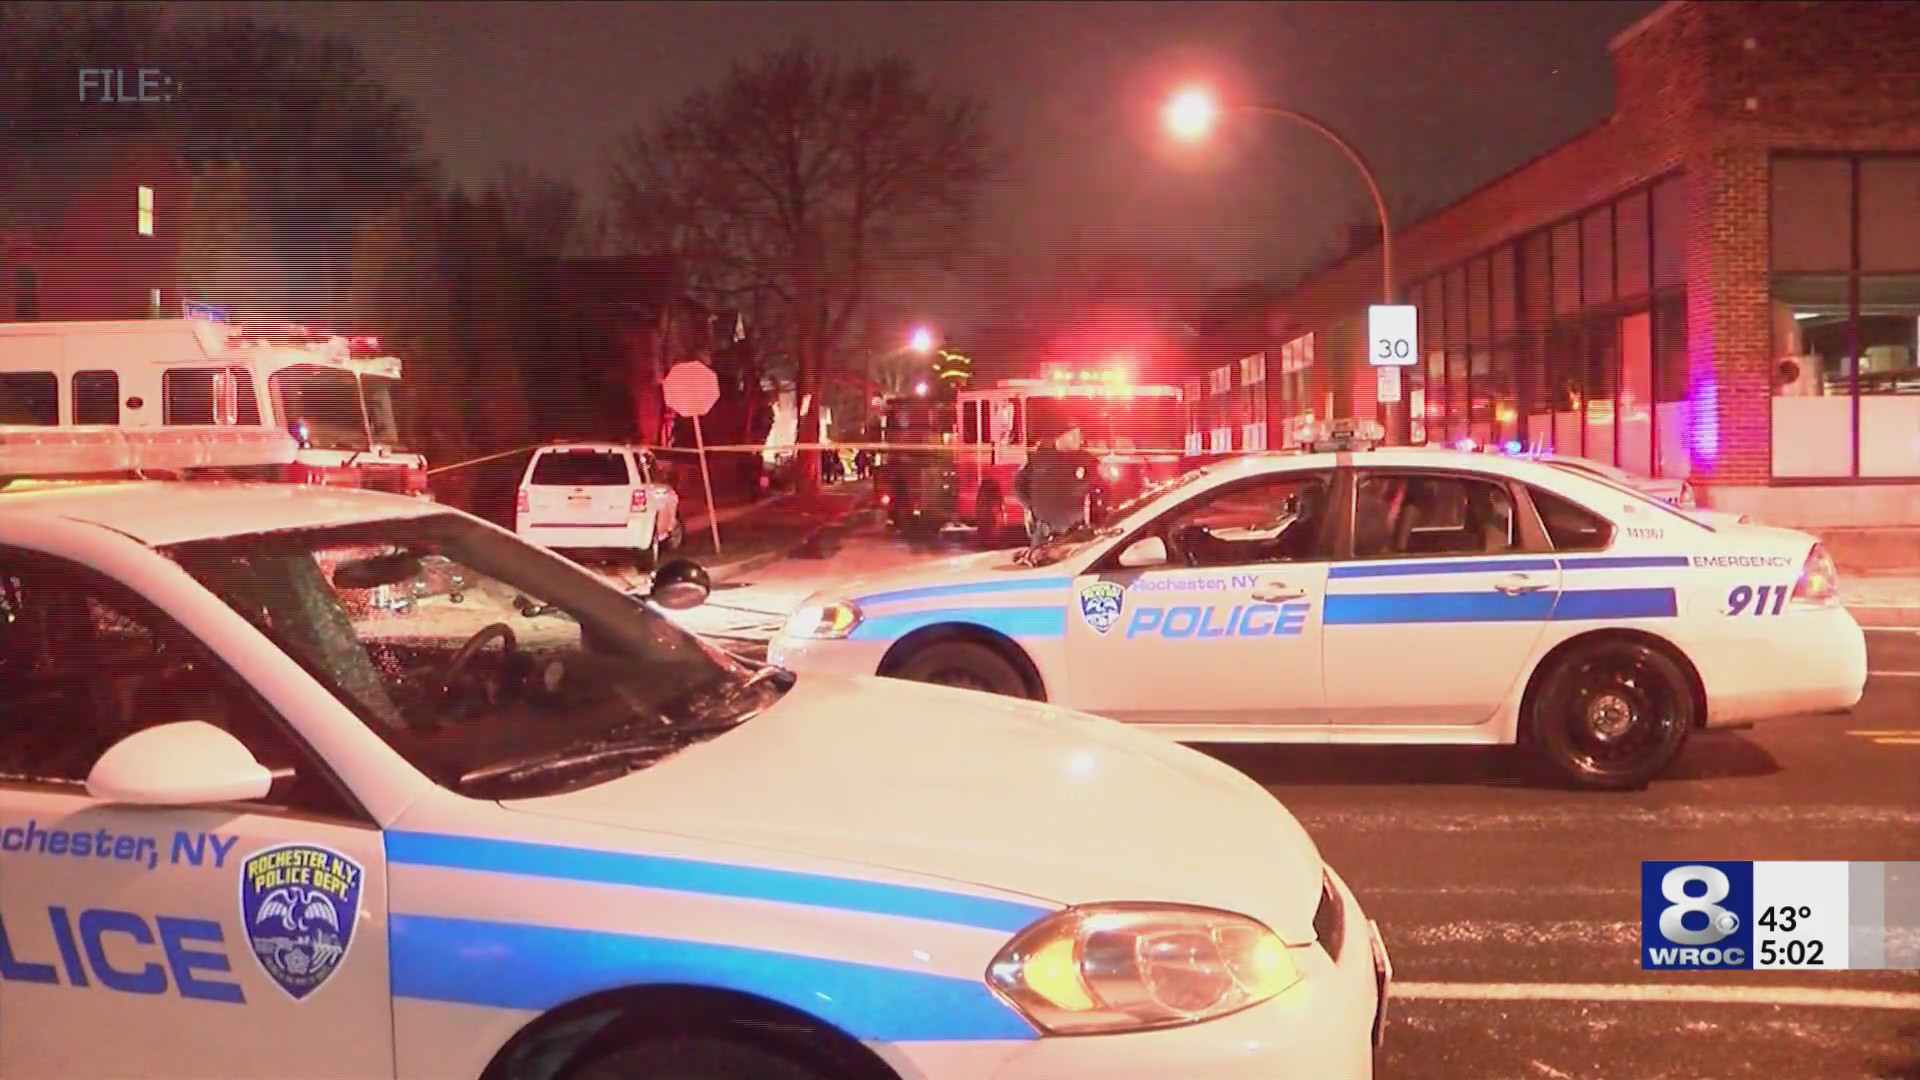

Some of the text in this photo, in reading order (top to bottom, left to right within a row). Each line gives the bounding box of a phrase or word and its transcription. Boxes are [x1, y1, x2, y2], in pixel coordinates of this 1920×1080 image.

[1378, 339, 1409, 358] 30
[1693, 556, 1793, 568] EMERGENCY
[1231, 576, 1259, 589] NY
[1727, 585, 1788, 616] 911
[1126, 603, 1311, 640] POLICE
[0, 819, 239, 869] chester, NY
[255, 867, 349, 902] POLICE DEPT.
